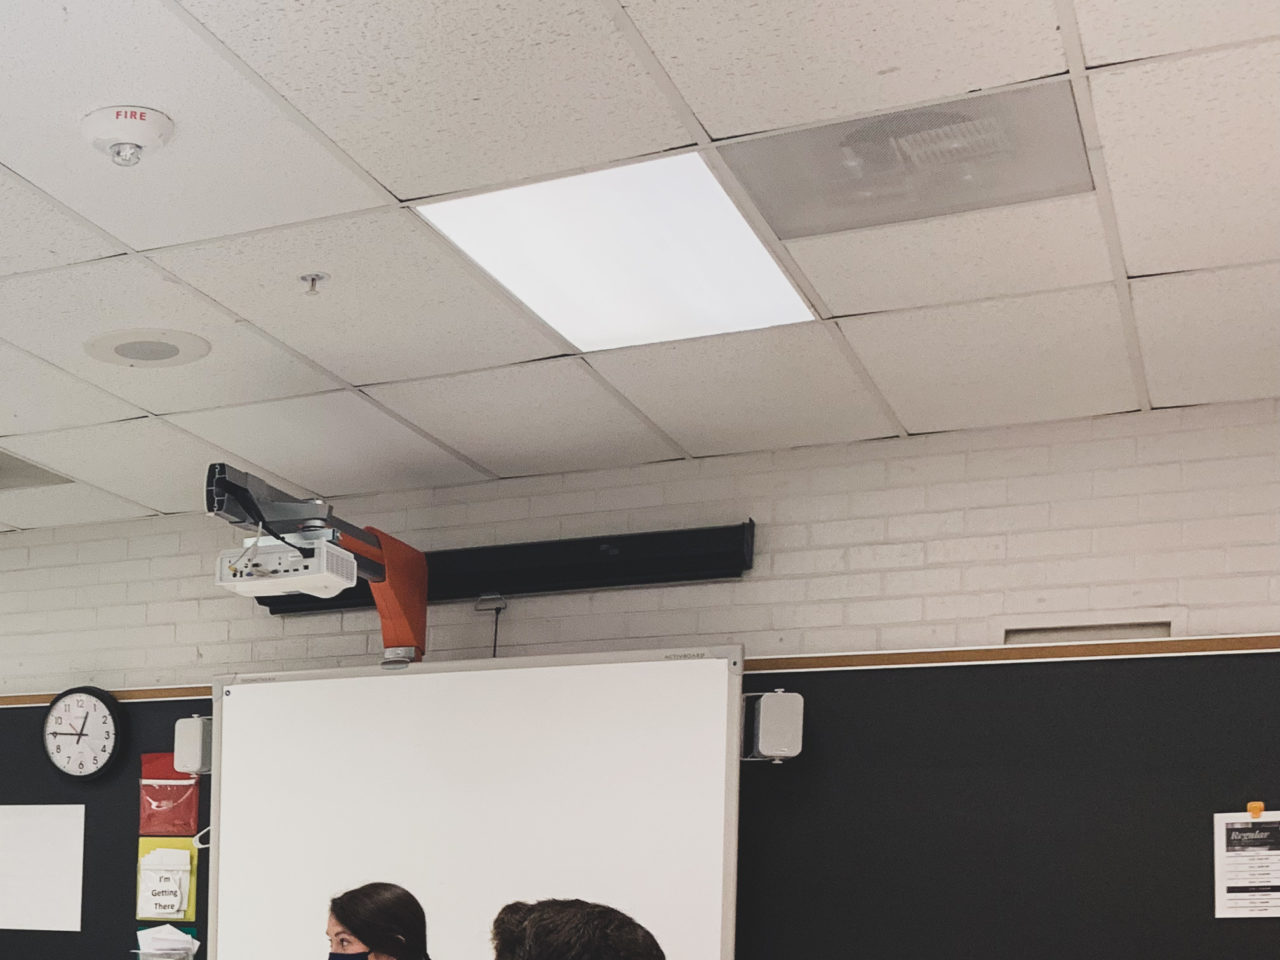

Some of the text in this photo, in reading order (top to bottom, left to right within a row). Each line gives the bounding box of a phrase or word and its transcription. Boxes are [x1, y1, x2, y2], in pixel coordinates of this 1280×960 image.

[116, 110, 146, 120] FIRE
[64, 704, 70, 712] 11
[76, 699, 84, 708] 12
[93, 704, 97, 712] 1
[55, 716, 62, 726] 10
[102, 715, 108, 724] 2
[104, 730, 110, 740] 3
[56, 744, 62, 754] 8
[101, 744, 106, 752] 4
[66, 756, 71, 764] 7
[92, 756, 98, 765] 5
[78, 760, 84, 770] 6
[1230, 830, 1270, 840] Regular
[152, 889, 178, 898] Getting
[154, 902, 176, 910] There
